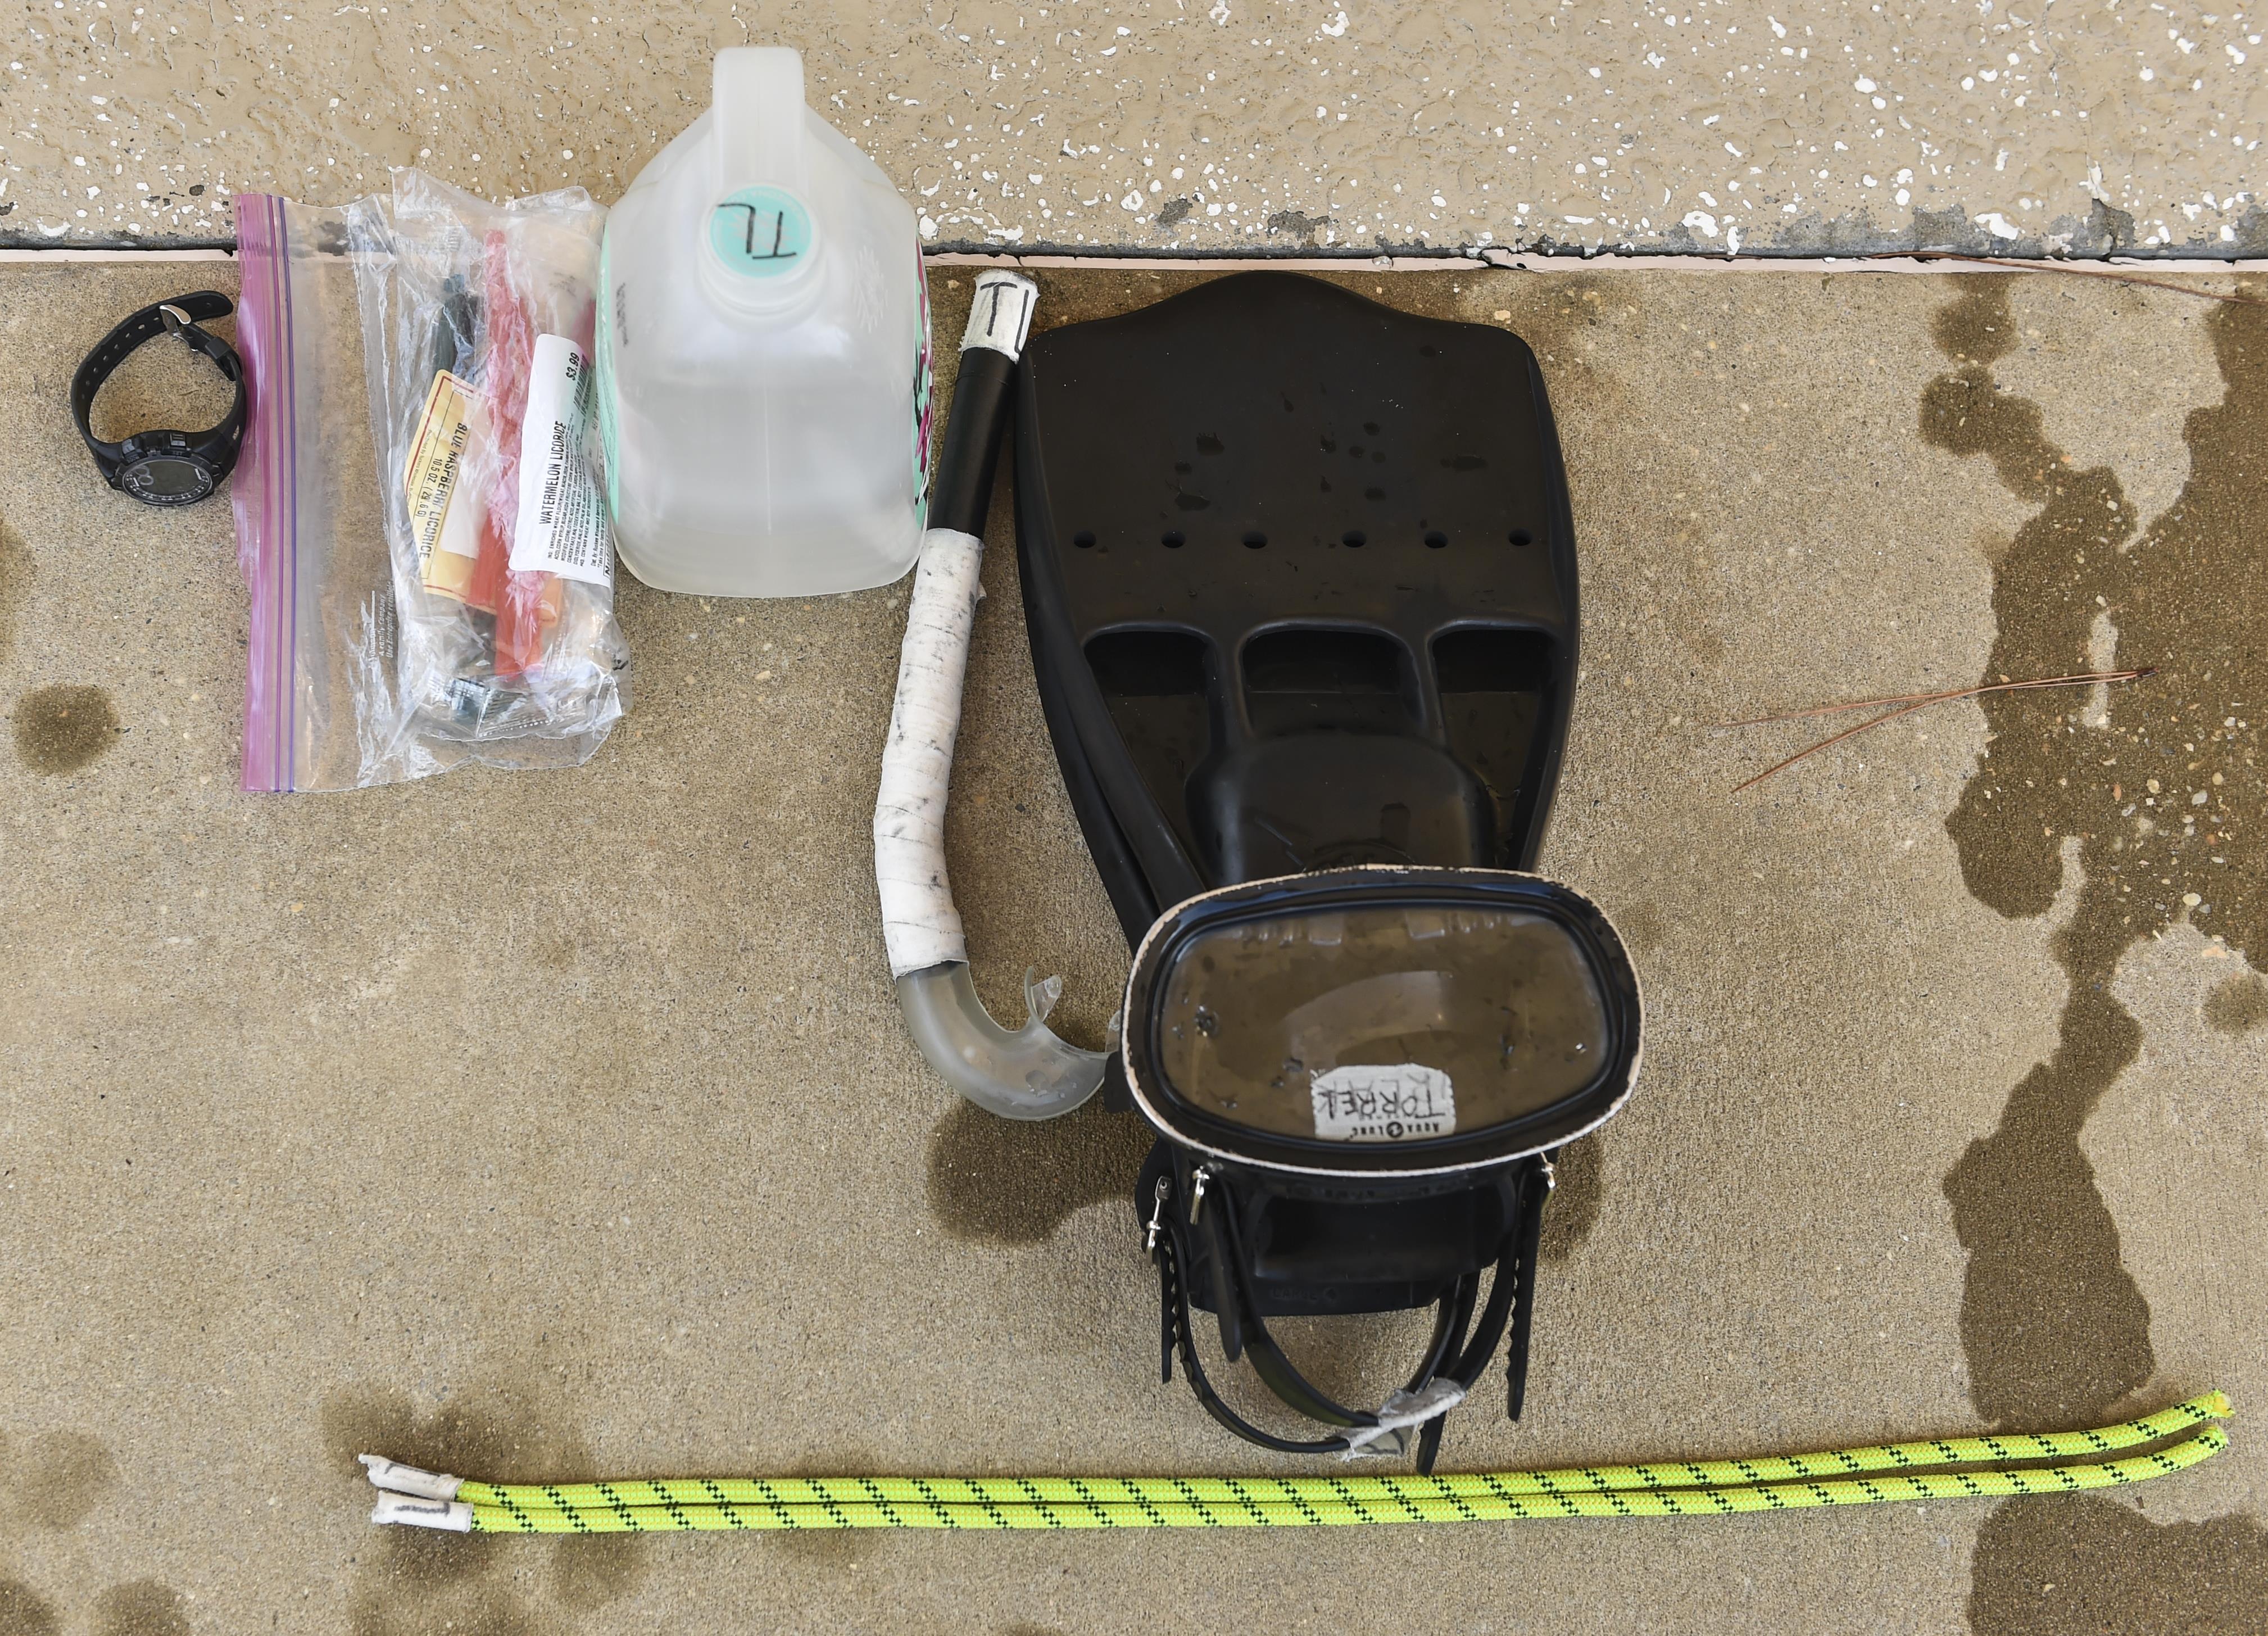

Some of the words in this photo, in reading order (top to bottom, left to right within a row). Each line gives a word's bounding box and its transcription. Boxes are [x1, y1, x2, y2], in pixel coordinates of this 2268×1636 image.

[716, 203, 797, 260] TL
[979, 282, 1029, 354] TL
[565, 352, 579, 381] $3.99
[451, 422, 468, 449] BLUE
[549, 420, 566, 460] LICORICE
[430, 459, 443, 472] 10.5
[539, 464, 561, 524] WATERMELON
[419, 511, 441, 559] LICORICE
[378, 593, 386, 625] Company
[1406, 1122, 1440, 1134] AQUA
